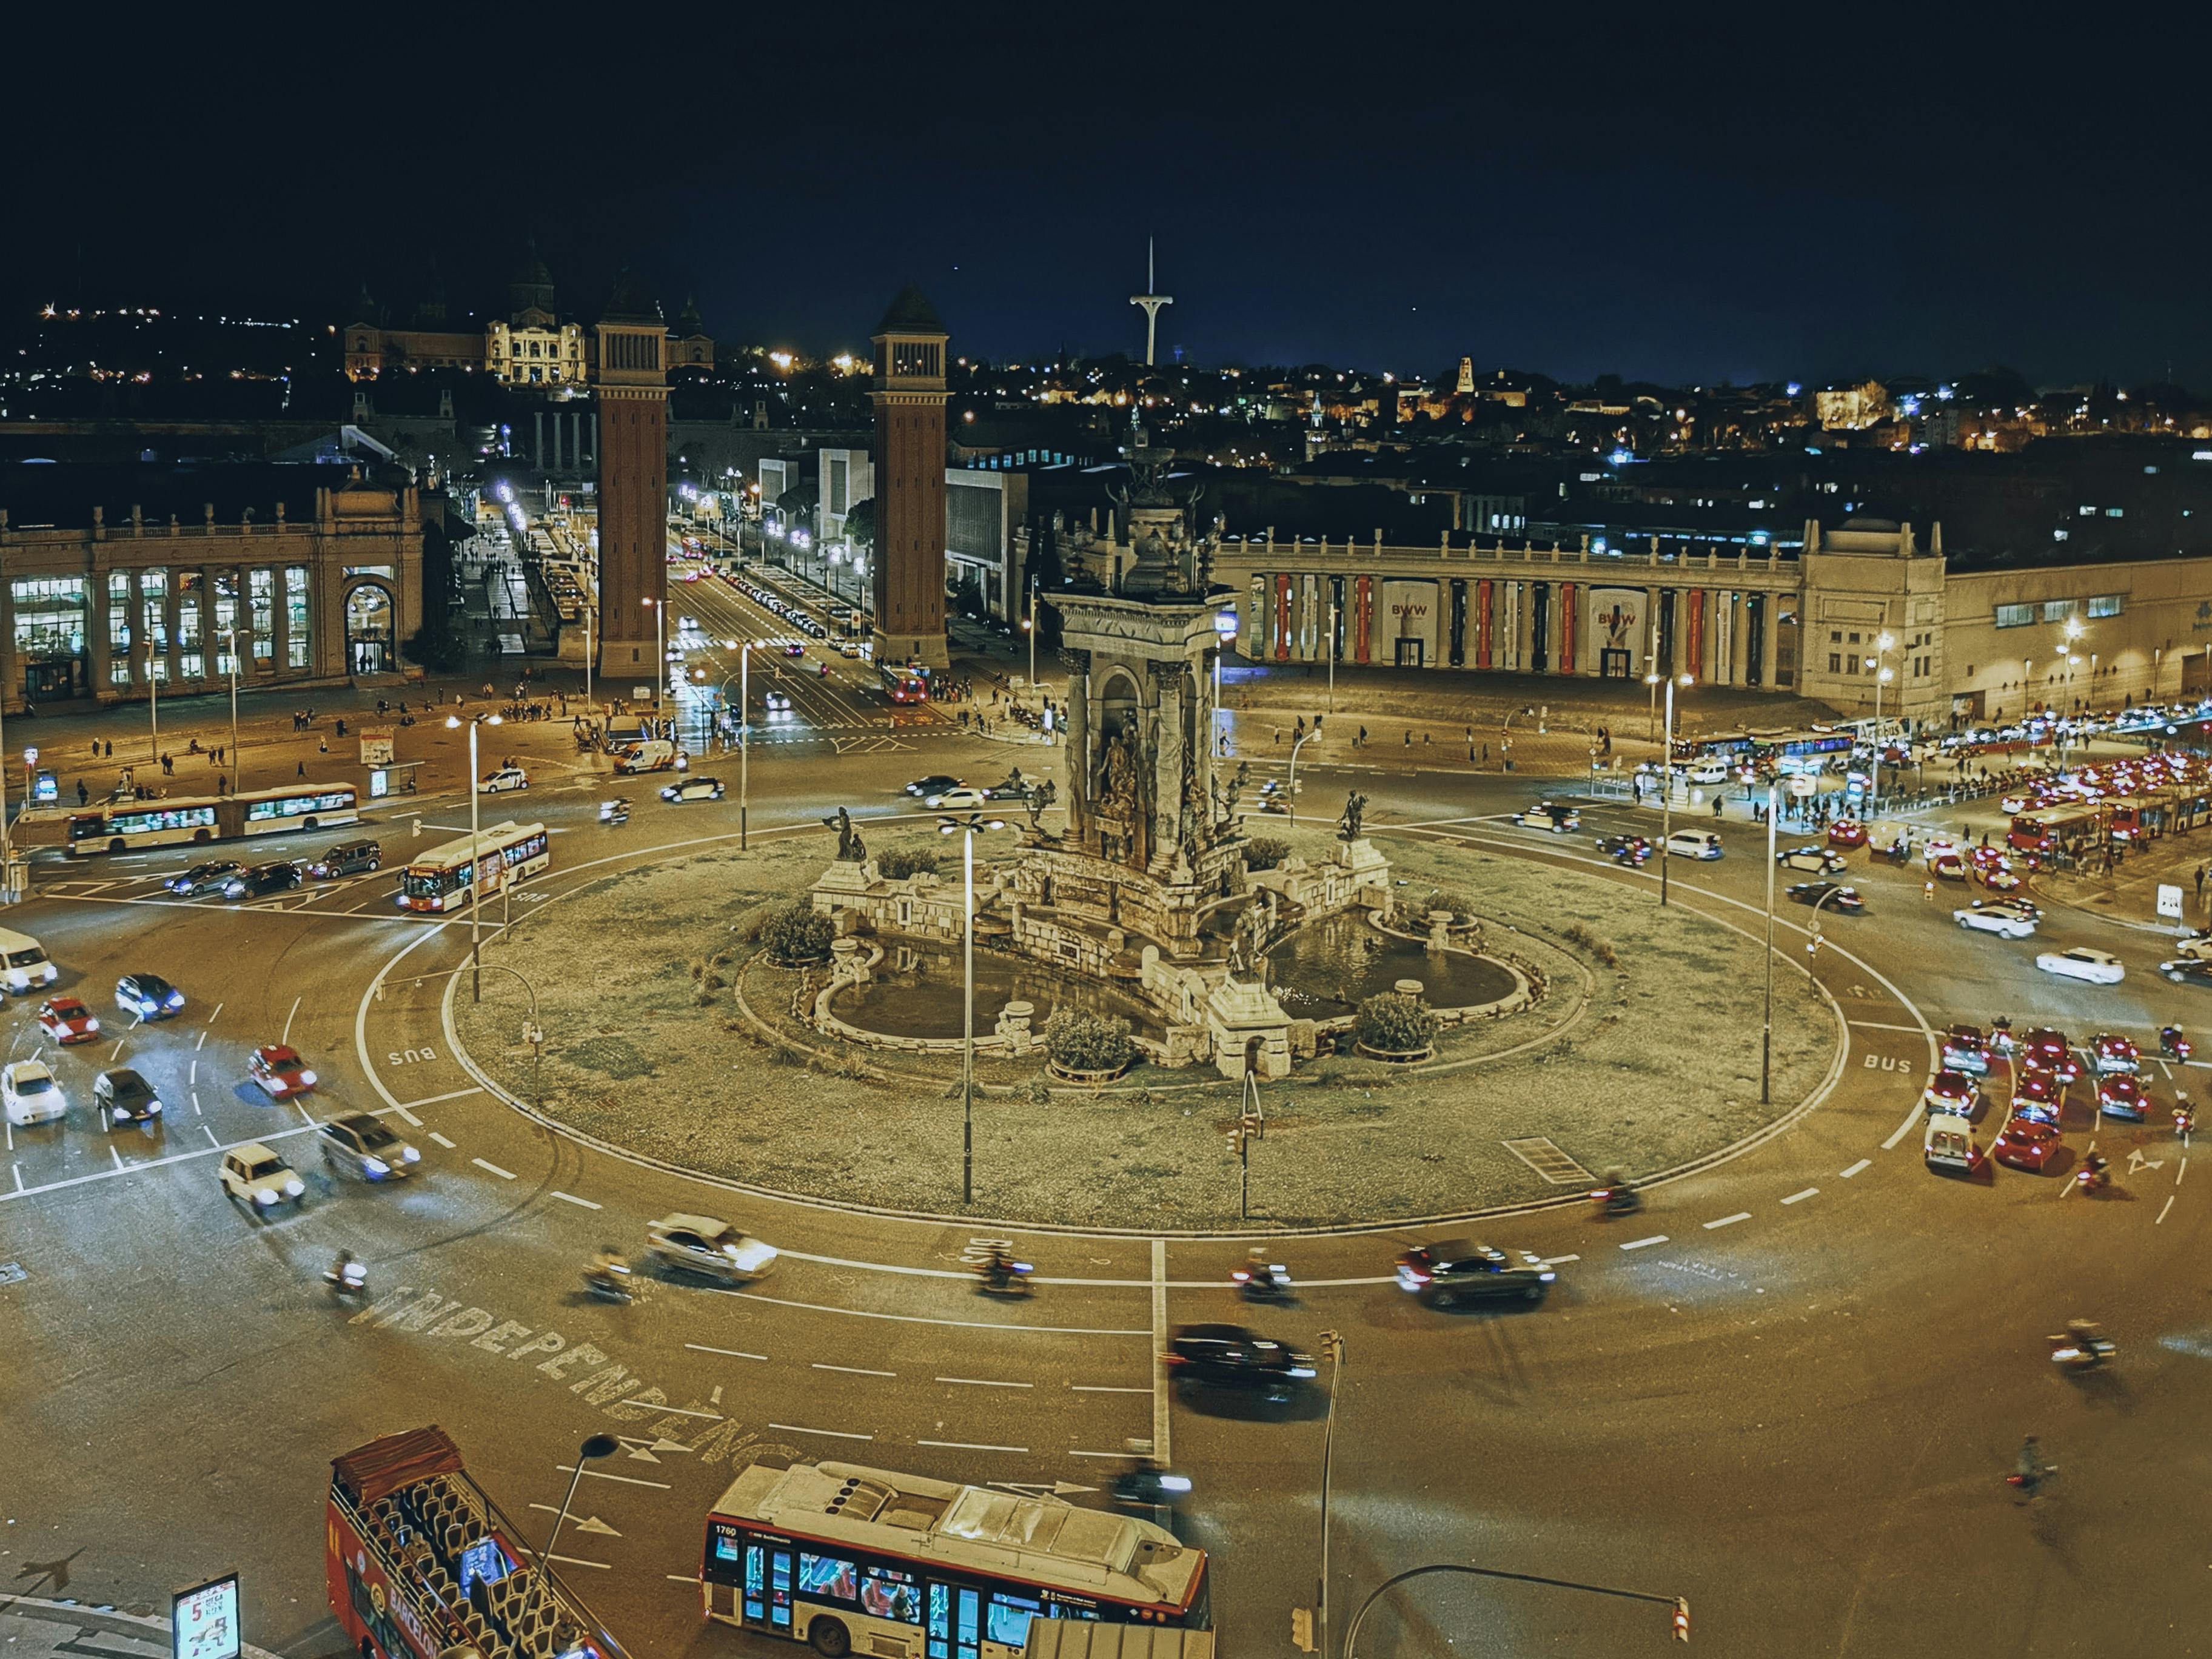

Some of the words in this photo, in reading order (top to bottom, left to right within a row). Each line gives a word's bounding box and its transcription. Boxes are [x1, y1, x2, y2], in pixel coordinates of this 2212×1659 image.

[1392, 605, 1427, 616] BWW
[1860, 725, 1900, 739] Aeobus
[511, 892, 550, 902] BUS
[388, 1047, 437, 1065] BUS
[1863, 1054, 1912, 1073] BUS
[347, 1286, 816, 1472] INDEPENDÈNC
[716, 1525, 737, 1537] 1760
[192, 1602, 203, 1621] 5
